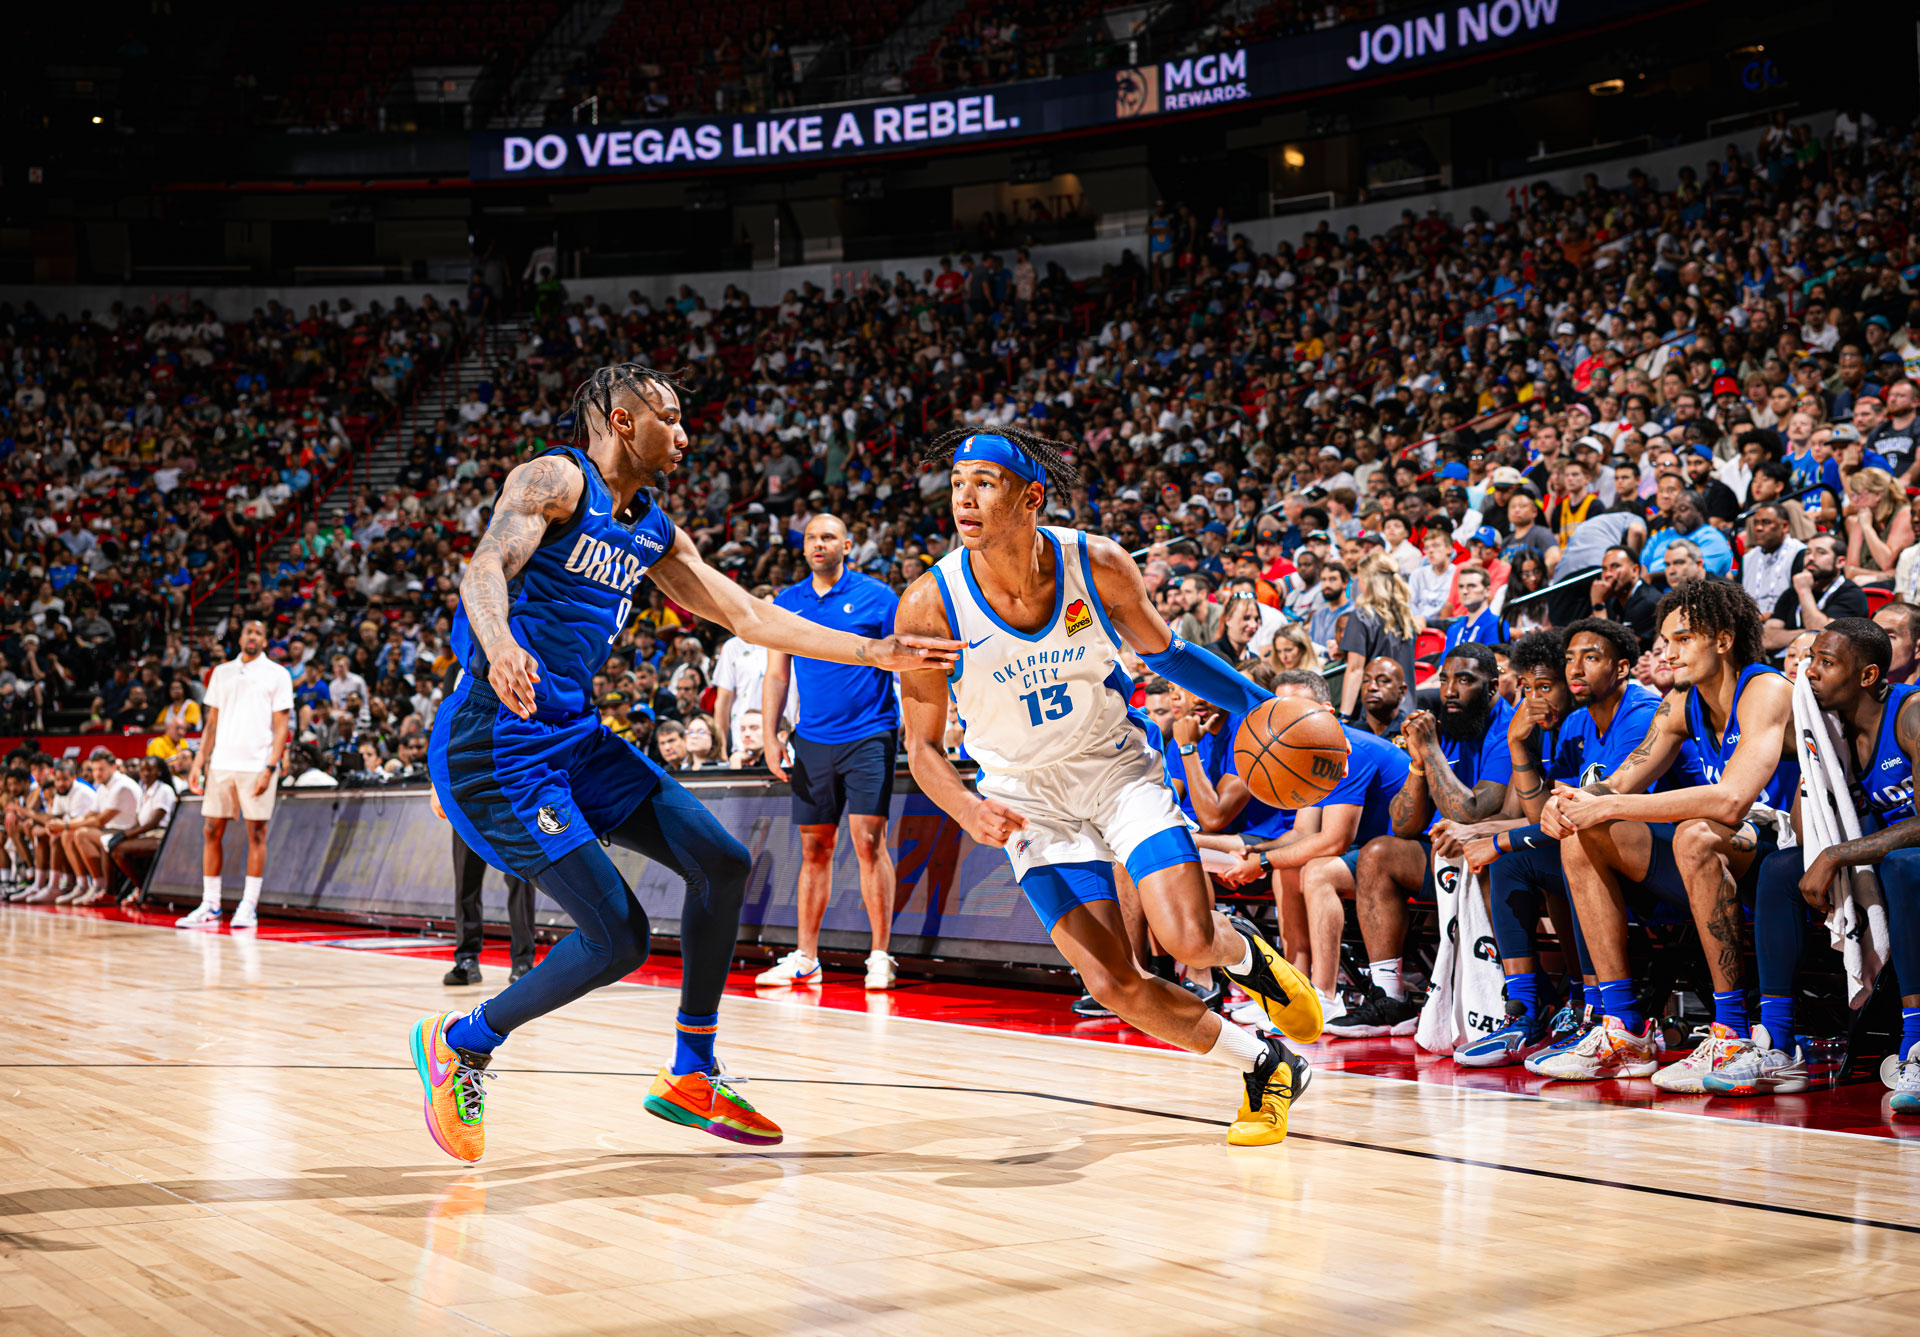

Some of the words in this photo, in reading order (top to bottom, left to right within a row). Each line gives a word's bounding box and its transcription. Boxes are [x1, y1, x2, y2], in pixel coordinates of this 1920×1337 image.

[1346, 13, 1446, 71] JOIN
[1457, 0, 1559, 46] NOW
[1164, 49, 1247, 92] MGM
[503, 135, 567, 171] DO
[576, 124, 722, 168] VEGAS
[732, 115, 823, 157] LIKE
[831, 113, 864, 148] A
[873, 95, 1021, 144] REBEL.
[635, 534, 664, 553] chime
[607, 597, 633, 645] 9
[993, 645, 1087, 684] OKLAHOMA
[1022, 668, 1060, 690] CITY
[1019, 682, 1074, 728] 13
[1726, 732, 1741, 744] chi
[1311, 755, 1343, 782] Wil
[1881, 756, 1903, 770] chime
